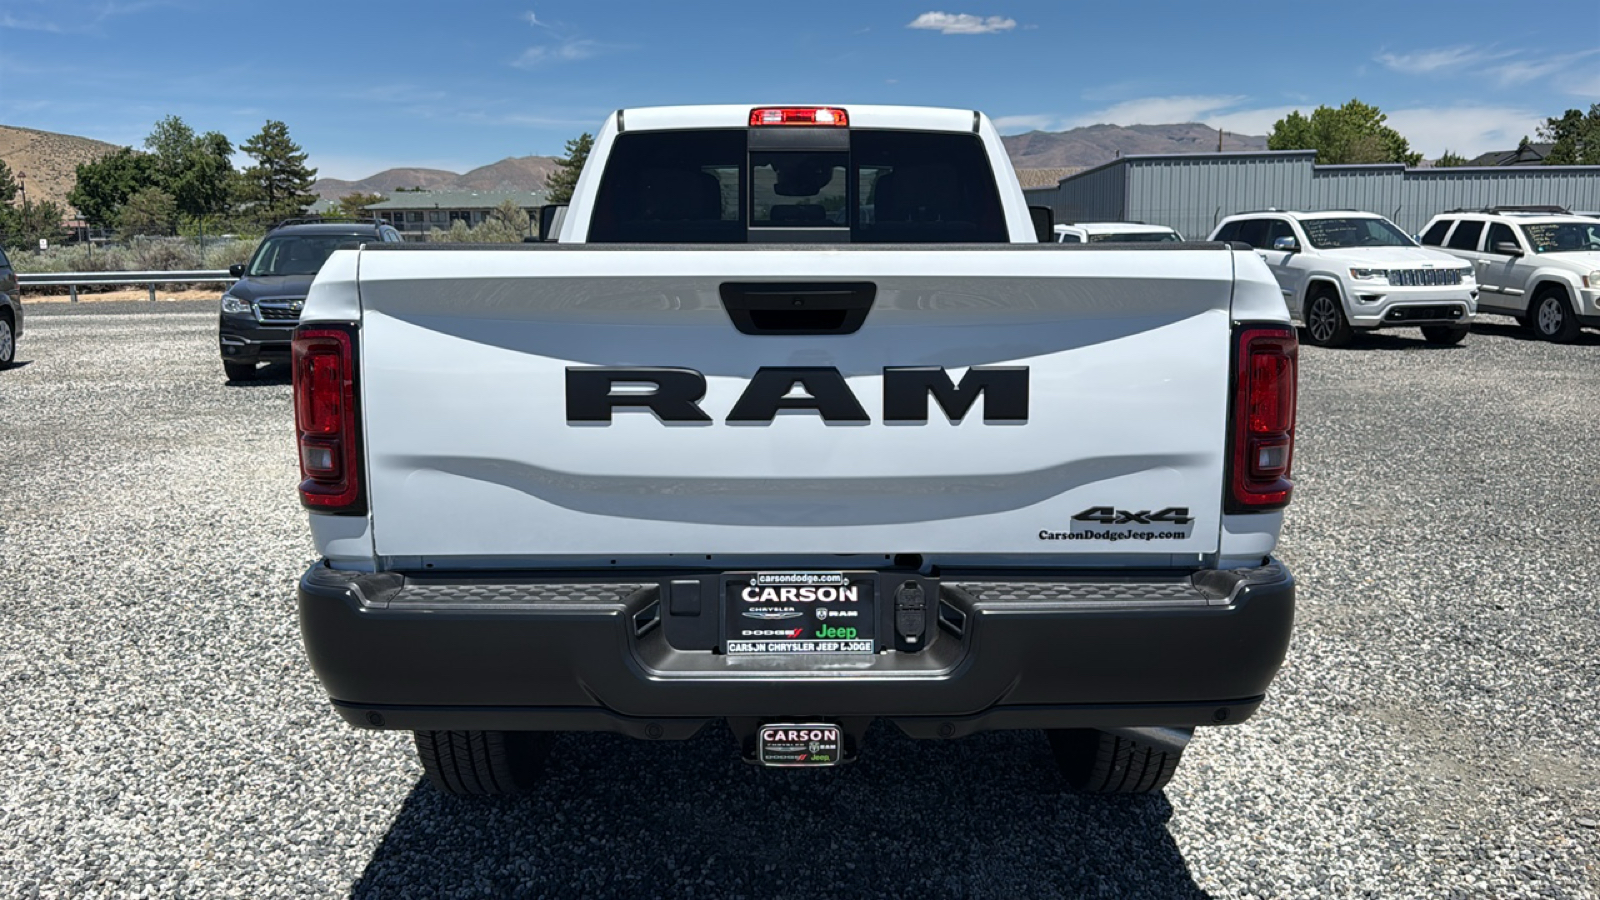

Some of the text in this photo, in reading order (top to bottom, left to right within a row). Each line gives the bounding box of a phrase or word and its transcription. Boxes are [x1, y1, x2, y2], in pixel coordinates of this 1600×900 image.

[565, 365, 1030, 424] RAM
[1071, 505, 1195, 525] 4x4
[1038, 529, 1186, 541] CarsonDodgeJeep.com
[759, 573, 841, 584] carsondodge.com
[741, 586, 858, 602] CARSON
[815, 624, 857, 640] Jeep
[729, 643, 766, 652] CARSON
[768, 643, 815, 652] CHRYSLER
[816, 642, 839, 651] JEEP
[763, 730, 836, 741] CARSON
